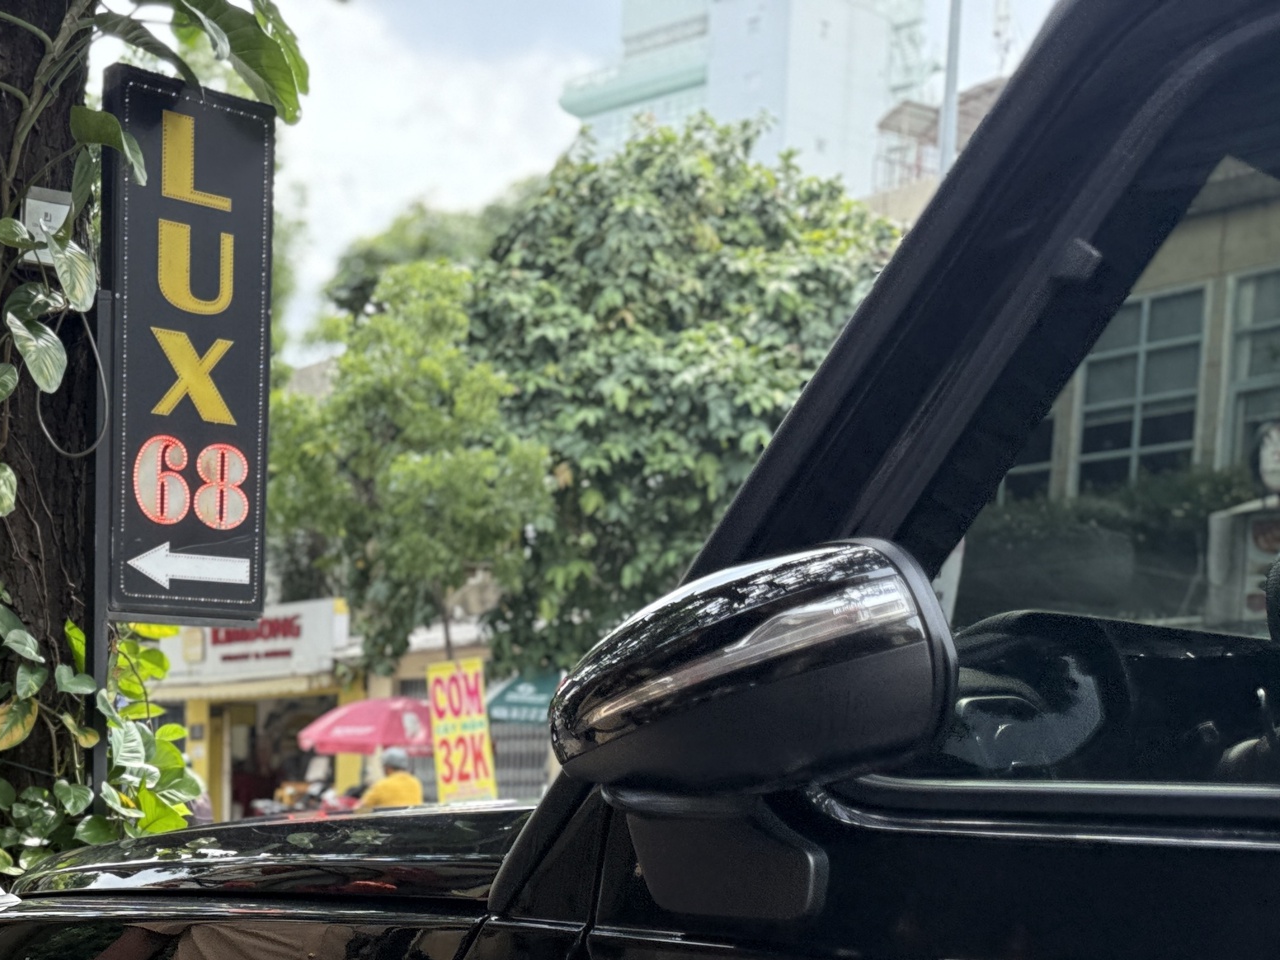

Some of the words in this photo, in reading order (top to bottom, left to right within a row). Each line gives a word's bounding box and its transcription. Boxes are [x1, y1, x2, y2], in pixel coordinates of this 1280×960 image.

[150, 109, 237, 426] LUX
[133, 434, 249, 530] 68
[438, 734, 490, 784] 32K
